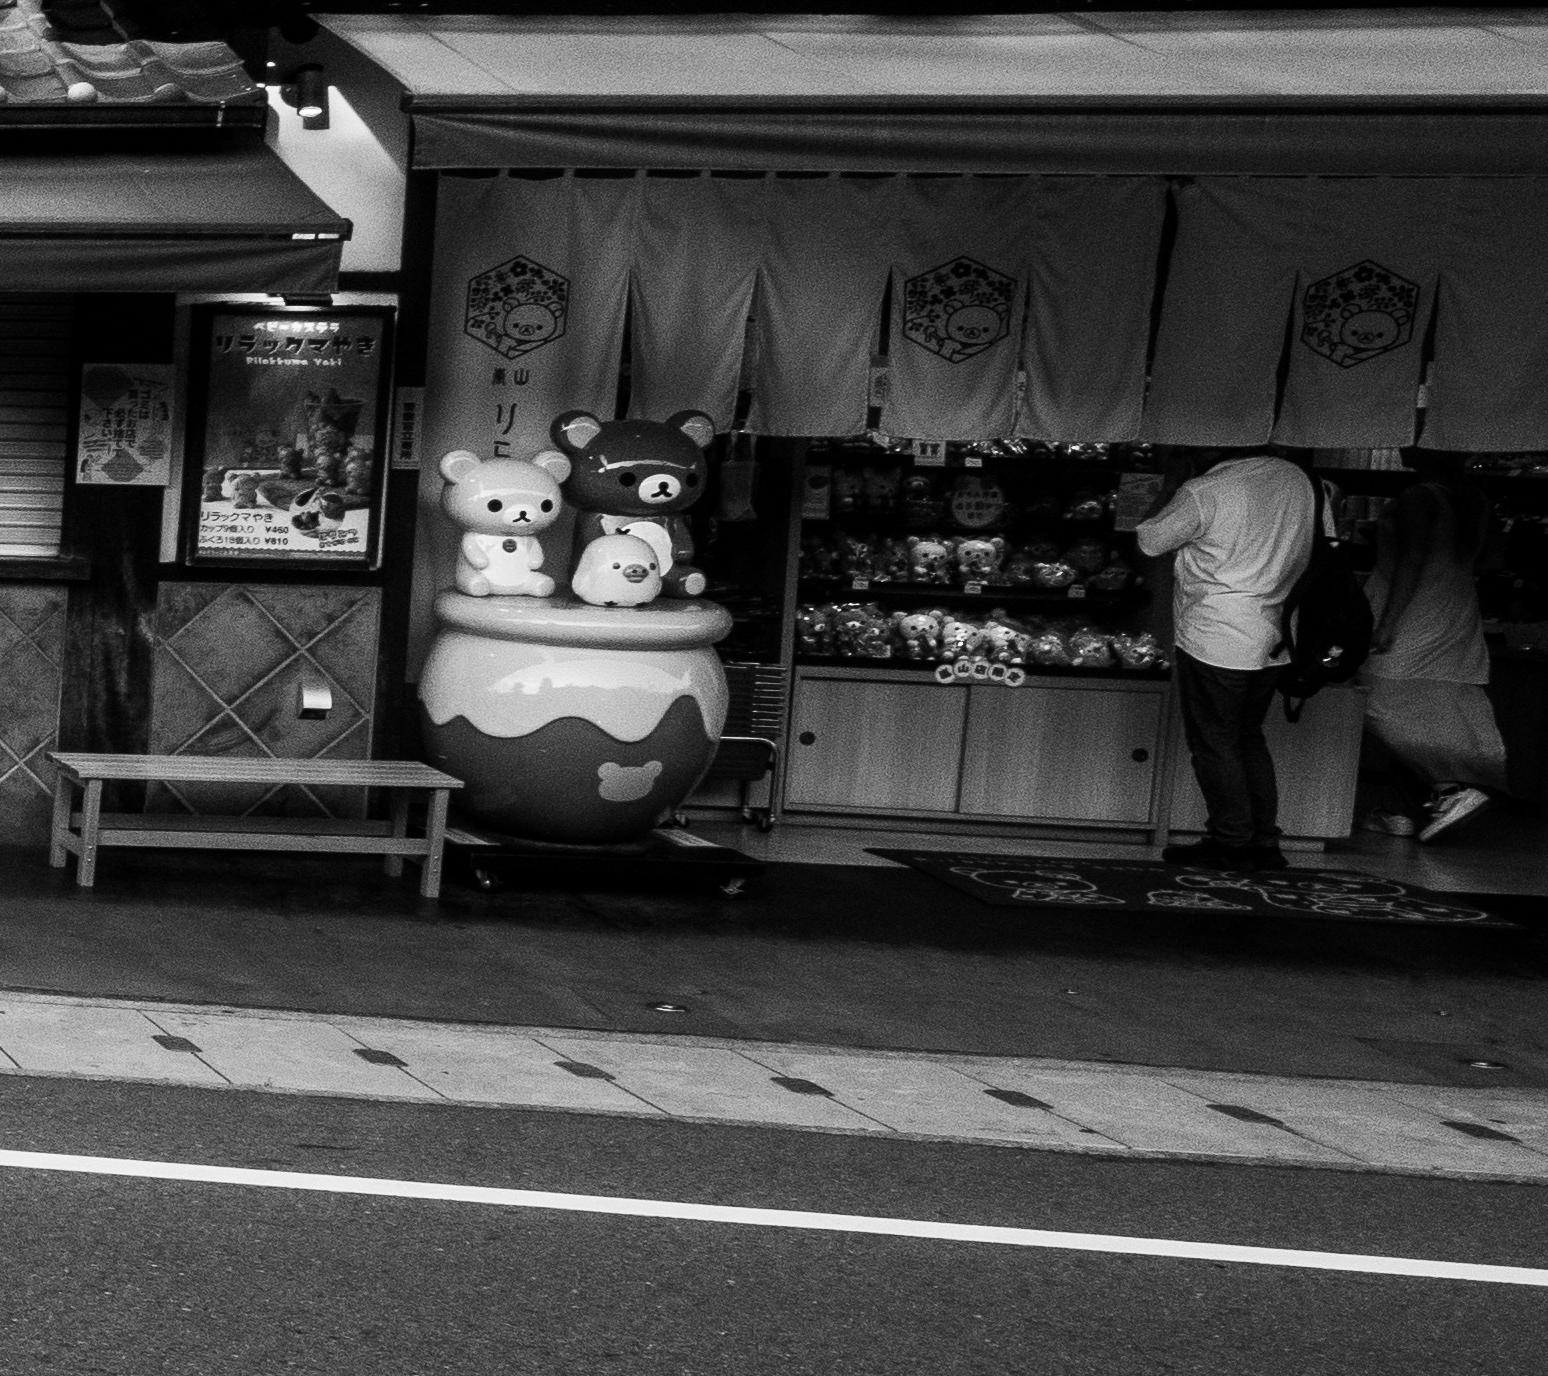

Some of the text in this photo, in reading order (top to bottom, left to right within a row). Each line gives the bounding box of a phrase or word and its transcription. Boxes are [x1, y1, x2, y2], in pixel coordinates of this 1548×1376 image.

[252, 321, 341, 333] ベビーカステラ
[215, 335, 378, 357] リラックマやき
[246, 356, 343, 367] Rilakkuma Yaki
[200, 511, 275, 524] リラックマやき
